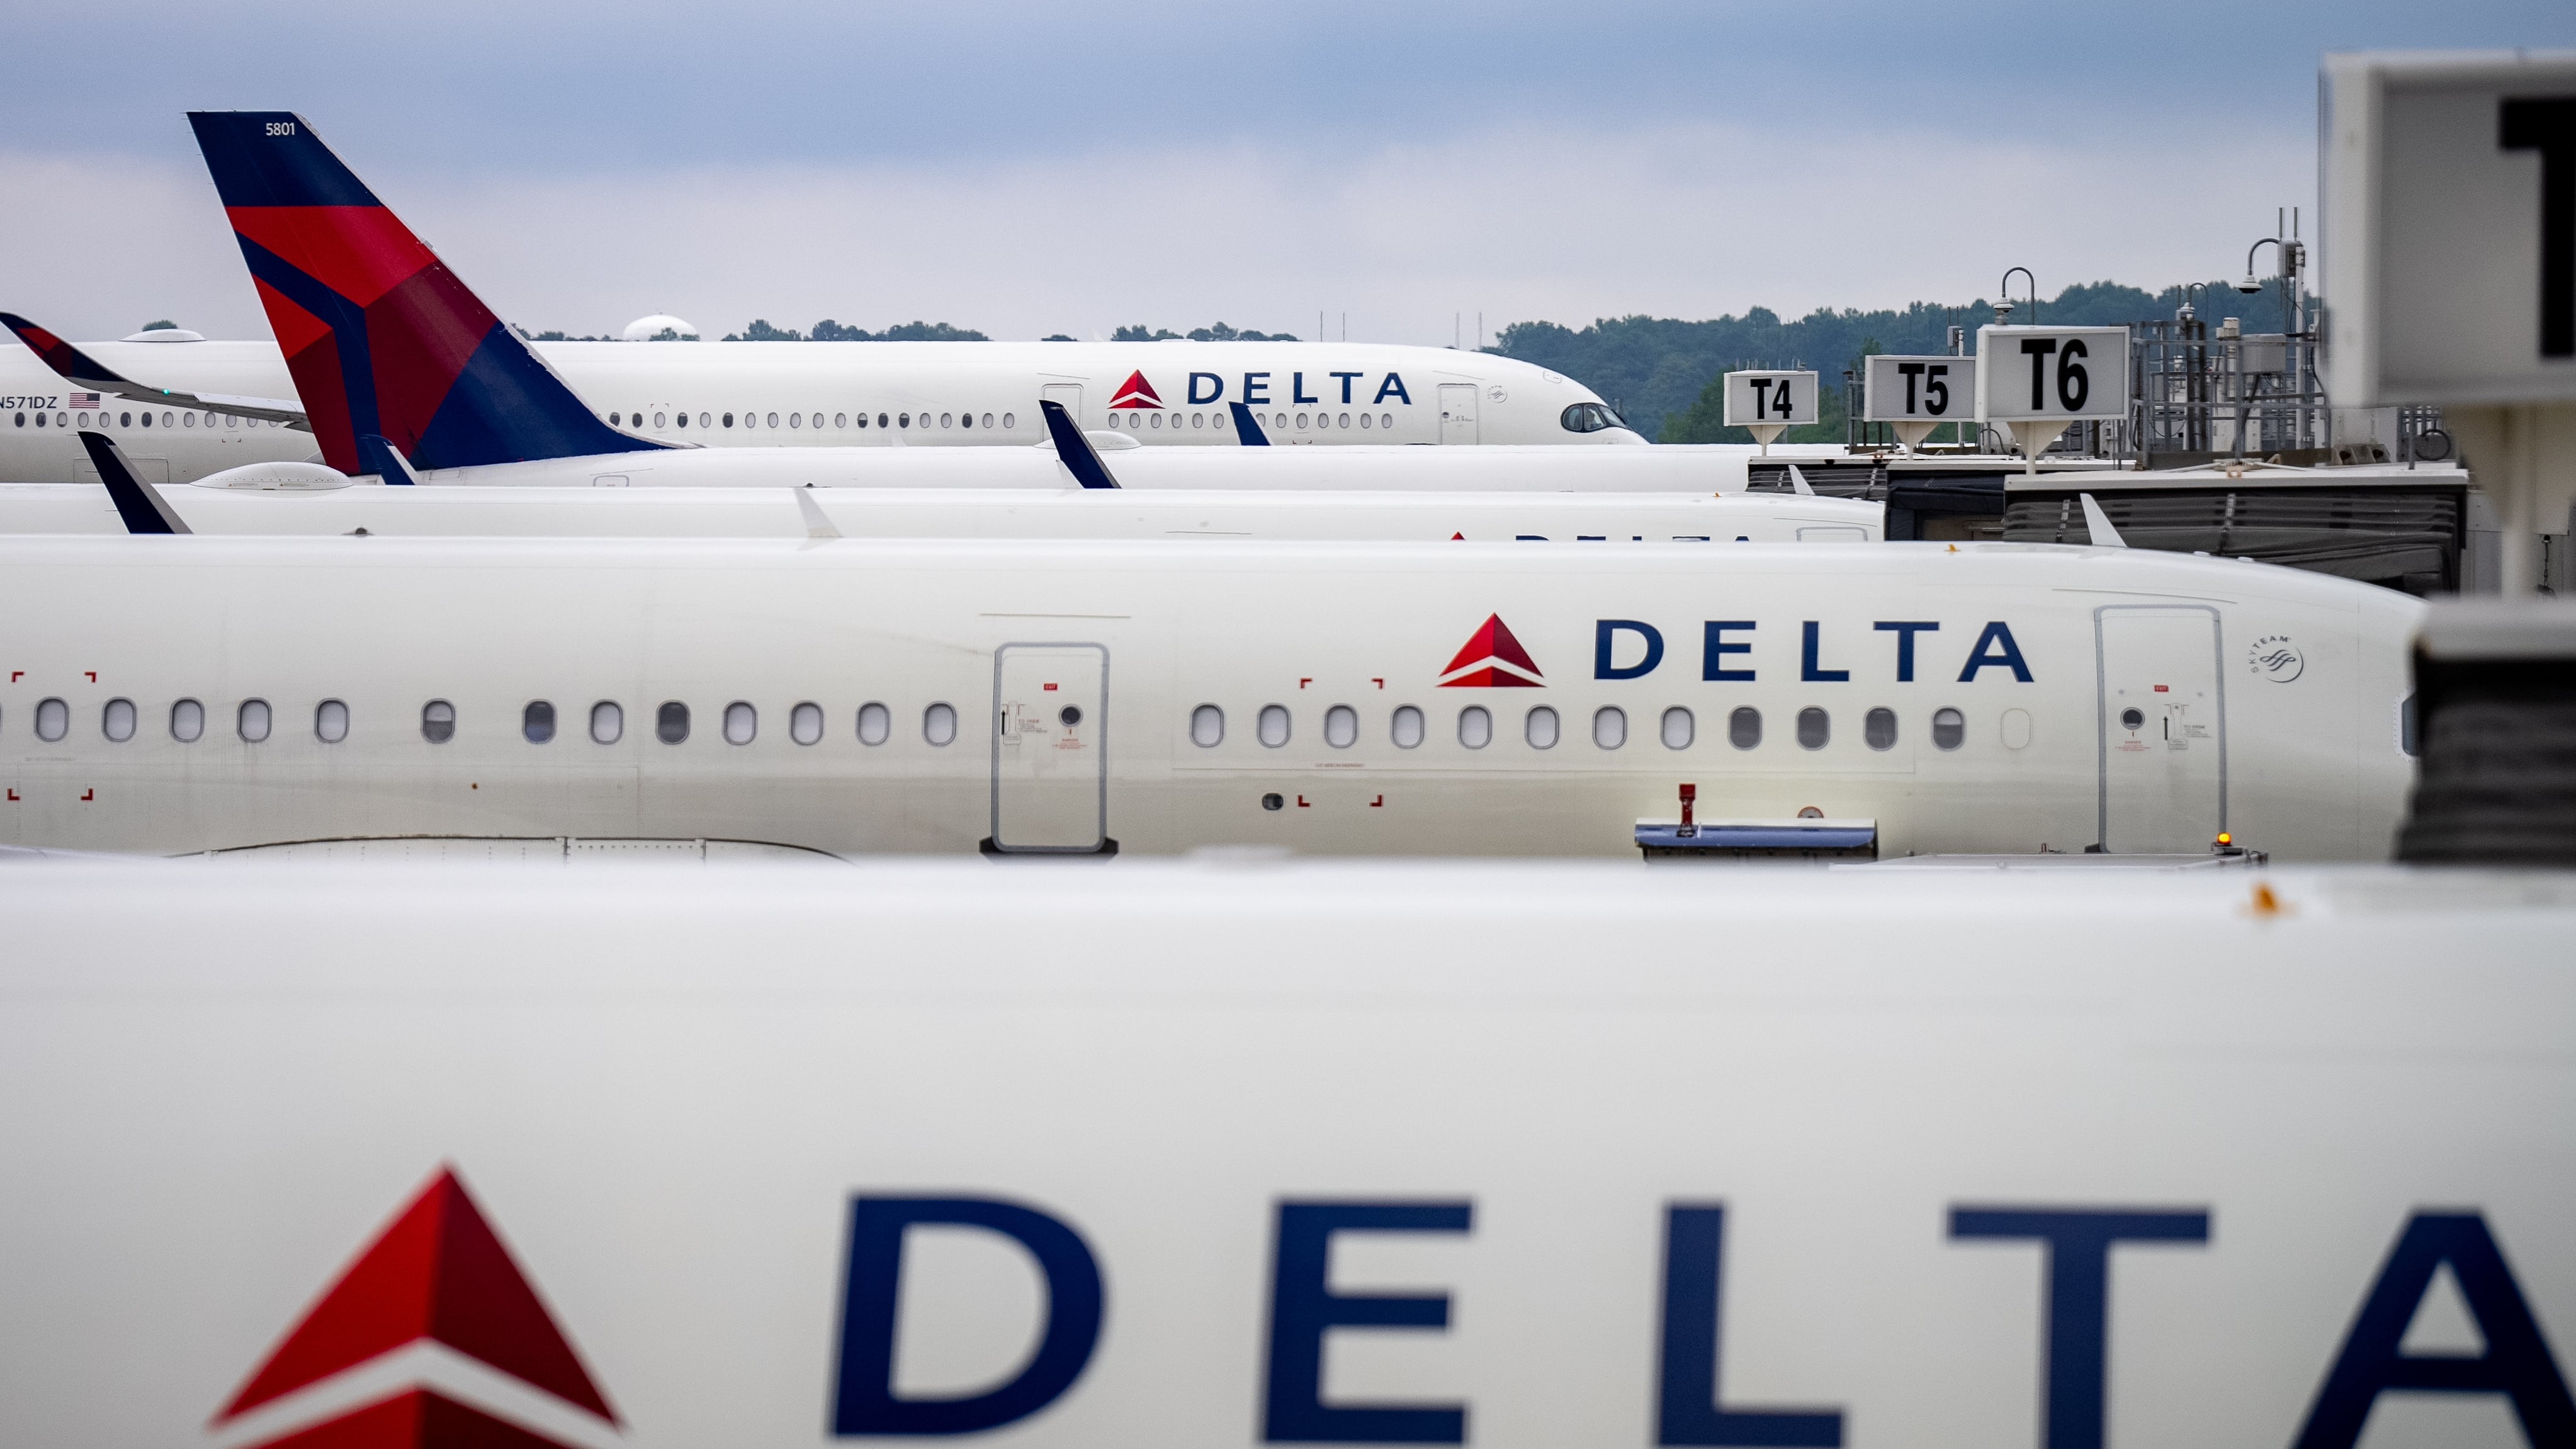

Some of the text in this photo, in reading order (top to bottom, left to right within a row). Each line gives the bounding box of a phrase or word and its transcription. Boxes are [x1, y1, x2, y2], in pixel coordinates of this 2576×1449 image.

[266, 122, 295, 135] 5801
[1187, 372, 1412, 405] DELTA
[1897, 363, 1949, 415] T5
[2021, 338, 2089, 412] T6
[1749, 378, 1793, 420] T4
[1593, 619, 2035, 683] DELTA
[2248, 635, 2289, 673] SKYTEAM
[825, 1191, 2576, 1449] DELTA
